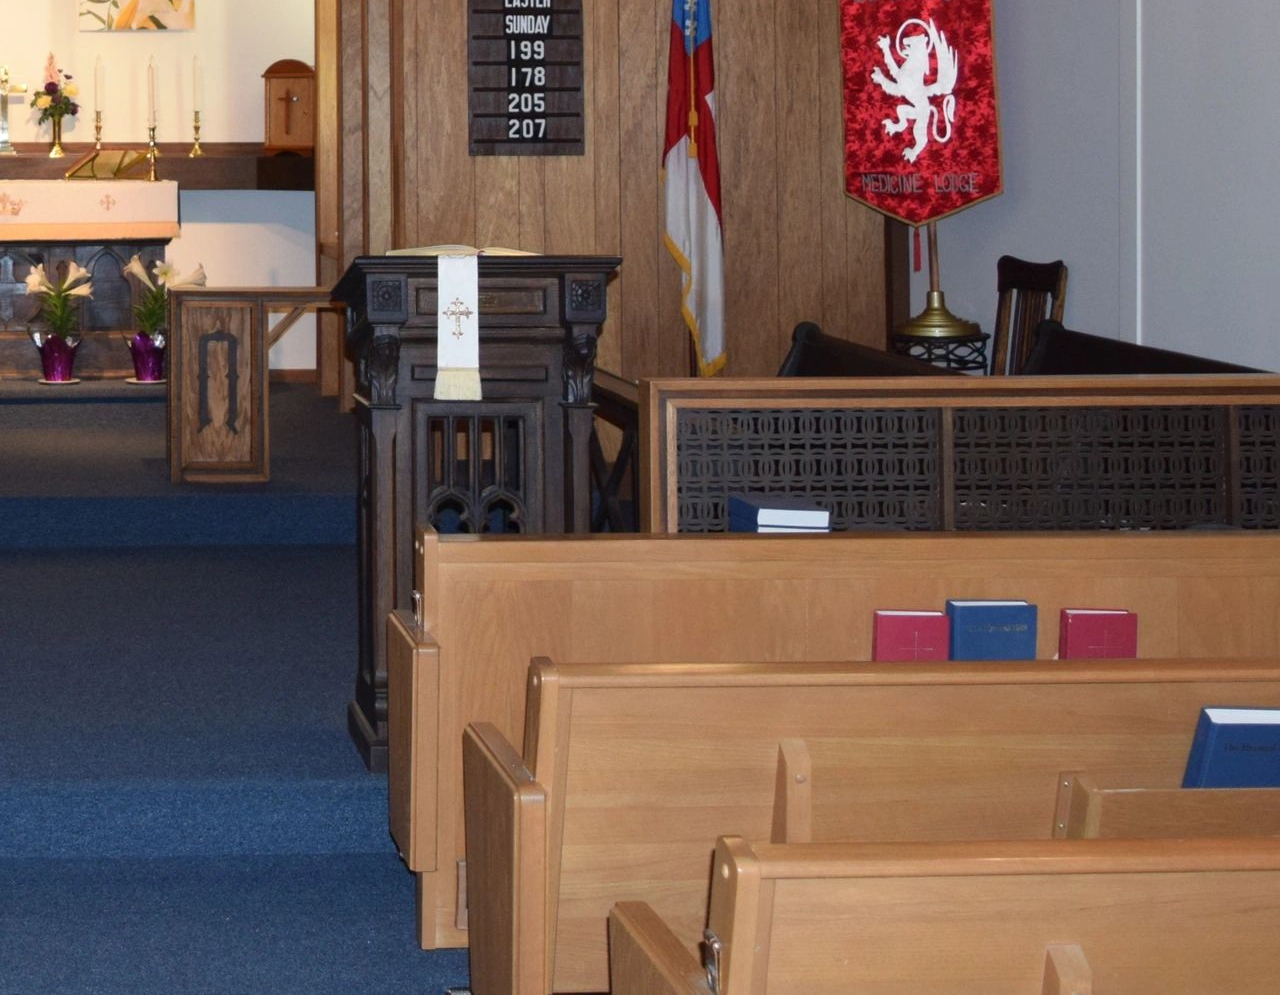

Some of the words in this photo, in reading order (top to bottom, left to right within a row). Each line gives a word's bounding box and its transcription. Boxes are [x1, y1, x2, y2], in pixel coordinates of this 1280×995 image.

[505, 15, 550, 34] SUNDAY
[510, 40, 545, 60] 199
[511, 67, 546, 87] 178
[508, 93, 545, 113] 205
[508, 119, 546, 139] 207
[862, 172, 922, 194] MEDICINE
[934, 172, 978, 193] LODGE
